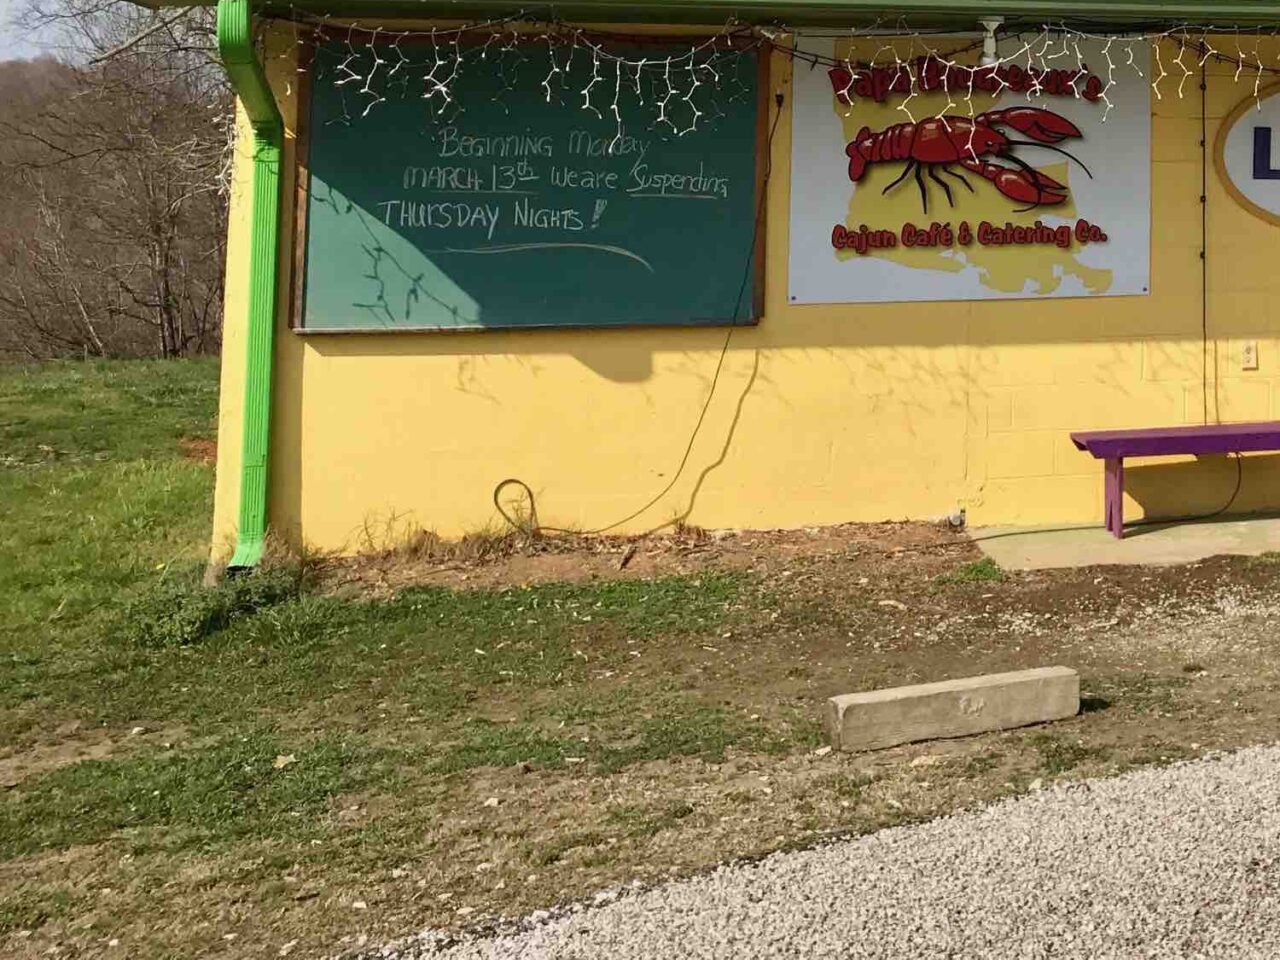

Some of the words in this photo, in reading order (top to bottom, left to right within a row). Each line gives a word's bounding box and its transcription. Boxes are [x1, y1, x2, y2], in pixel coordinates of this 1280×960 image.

[831, 224, 897, 254] Cajun
[901, 222, 953, 247] Café
[958, 221, 973, 246] &
[977, 220, 1072, 248] Catering
[1074, 219, 1108, 243] Co.
